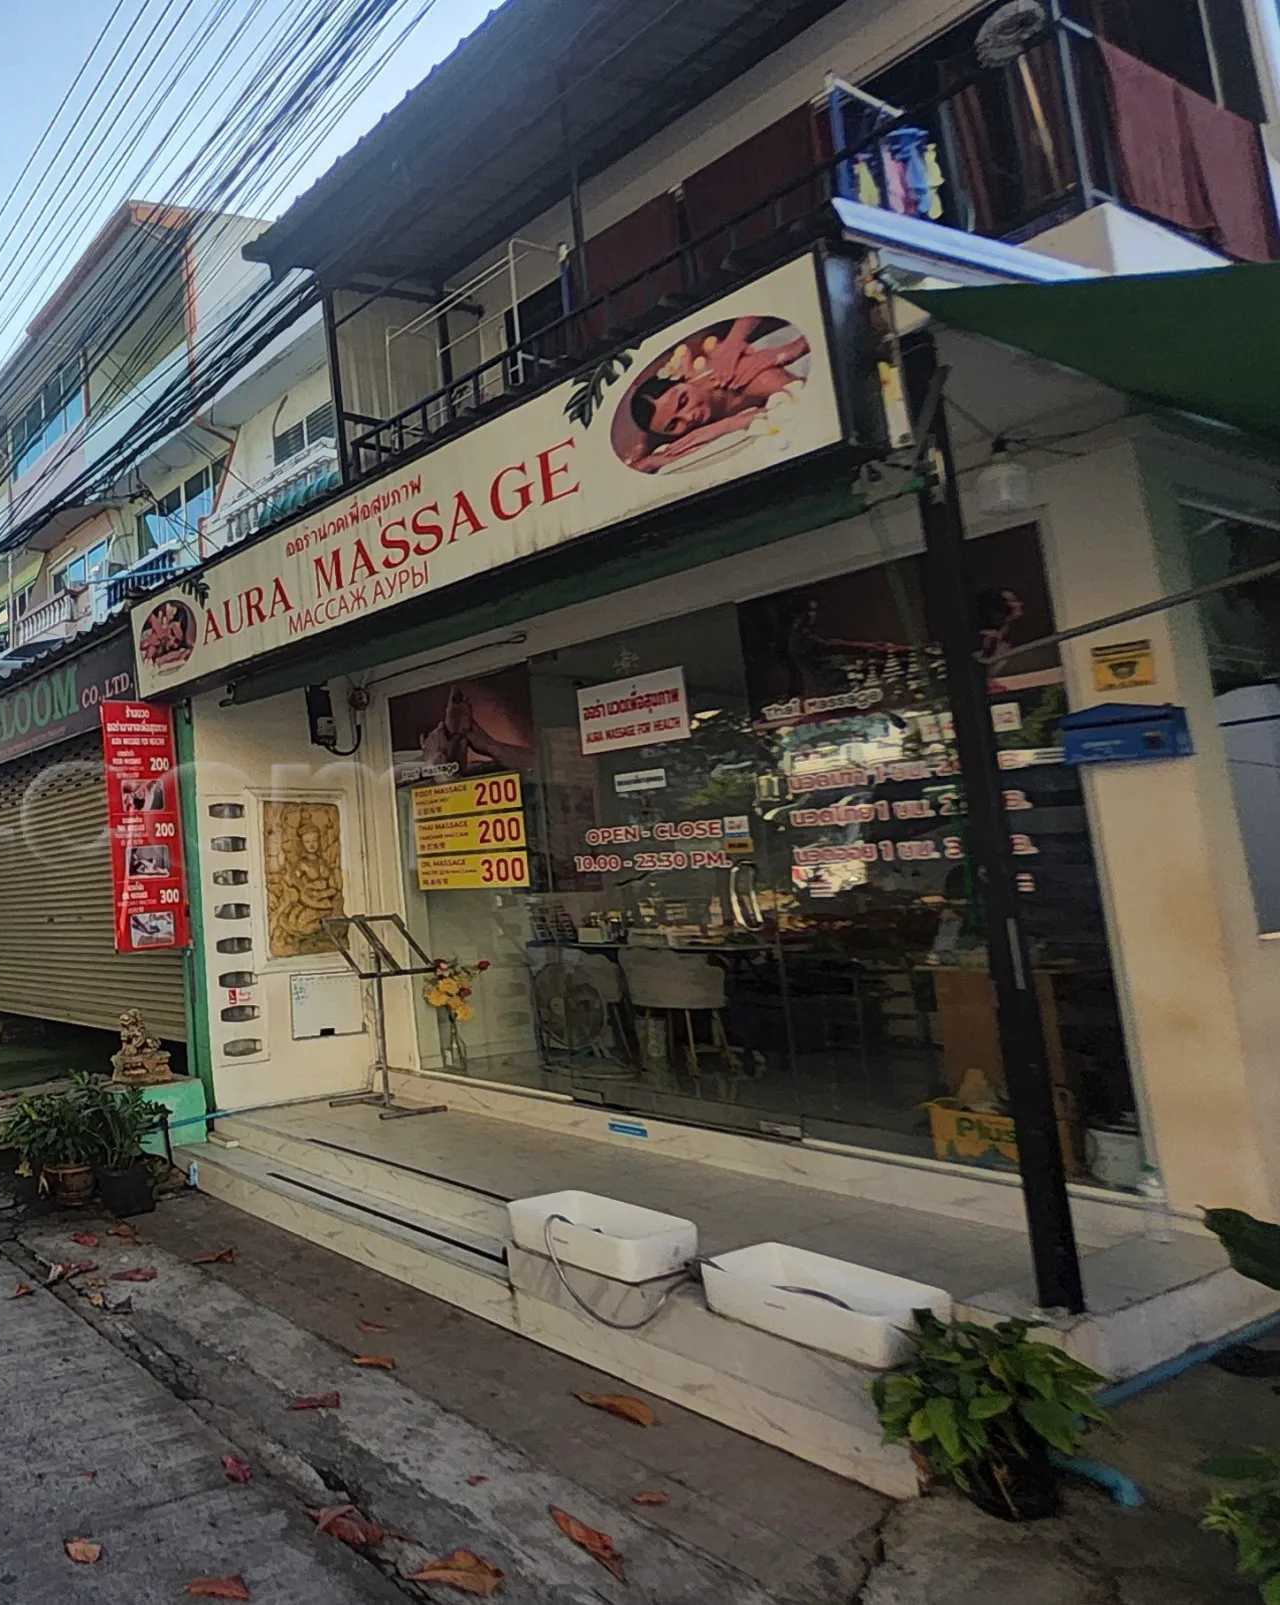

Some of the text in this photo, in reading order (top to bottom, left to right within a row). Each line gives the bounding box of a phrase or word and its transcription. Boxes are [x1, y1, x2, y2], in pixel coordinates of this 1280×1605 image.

[203, 438, 581, 646] AURA MASSAGE
[288, 561, 430, 636] МАССАЖ АУРЫ
[637, 722, 651, 736] FOR
[149, 757, 169, 771] 200
[434, 784, 467, 795] MASSAGE
[474, 779, 517, 807] 200
[155, 823, 175, 837] 200
[435, 820, 468, 830] MASSAGE
[478, 817, 521, 844] 200
[585, 825, 640, 846] OPEN
[653, 820, 723, 841] CLOSE
[433, 858, 466, 867] MASSAGE
[481, 857, 524, 883] 300
[574, 854, 621, 872] 10.00
[634, 851, 687, 871] 23.30
[690, 850, 733, 869] PM.
[160, 888, 179, 904] 300
[956, 1116, 1017, 1143] Plus
